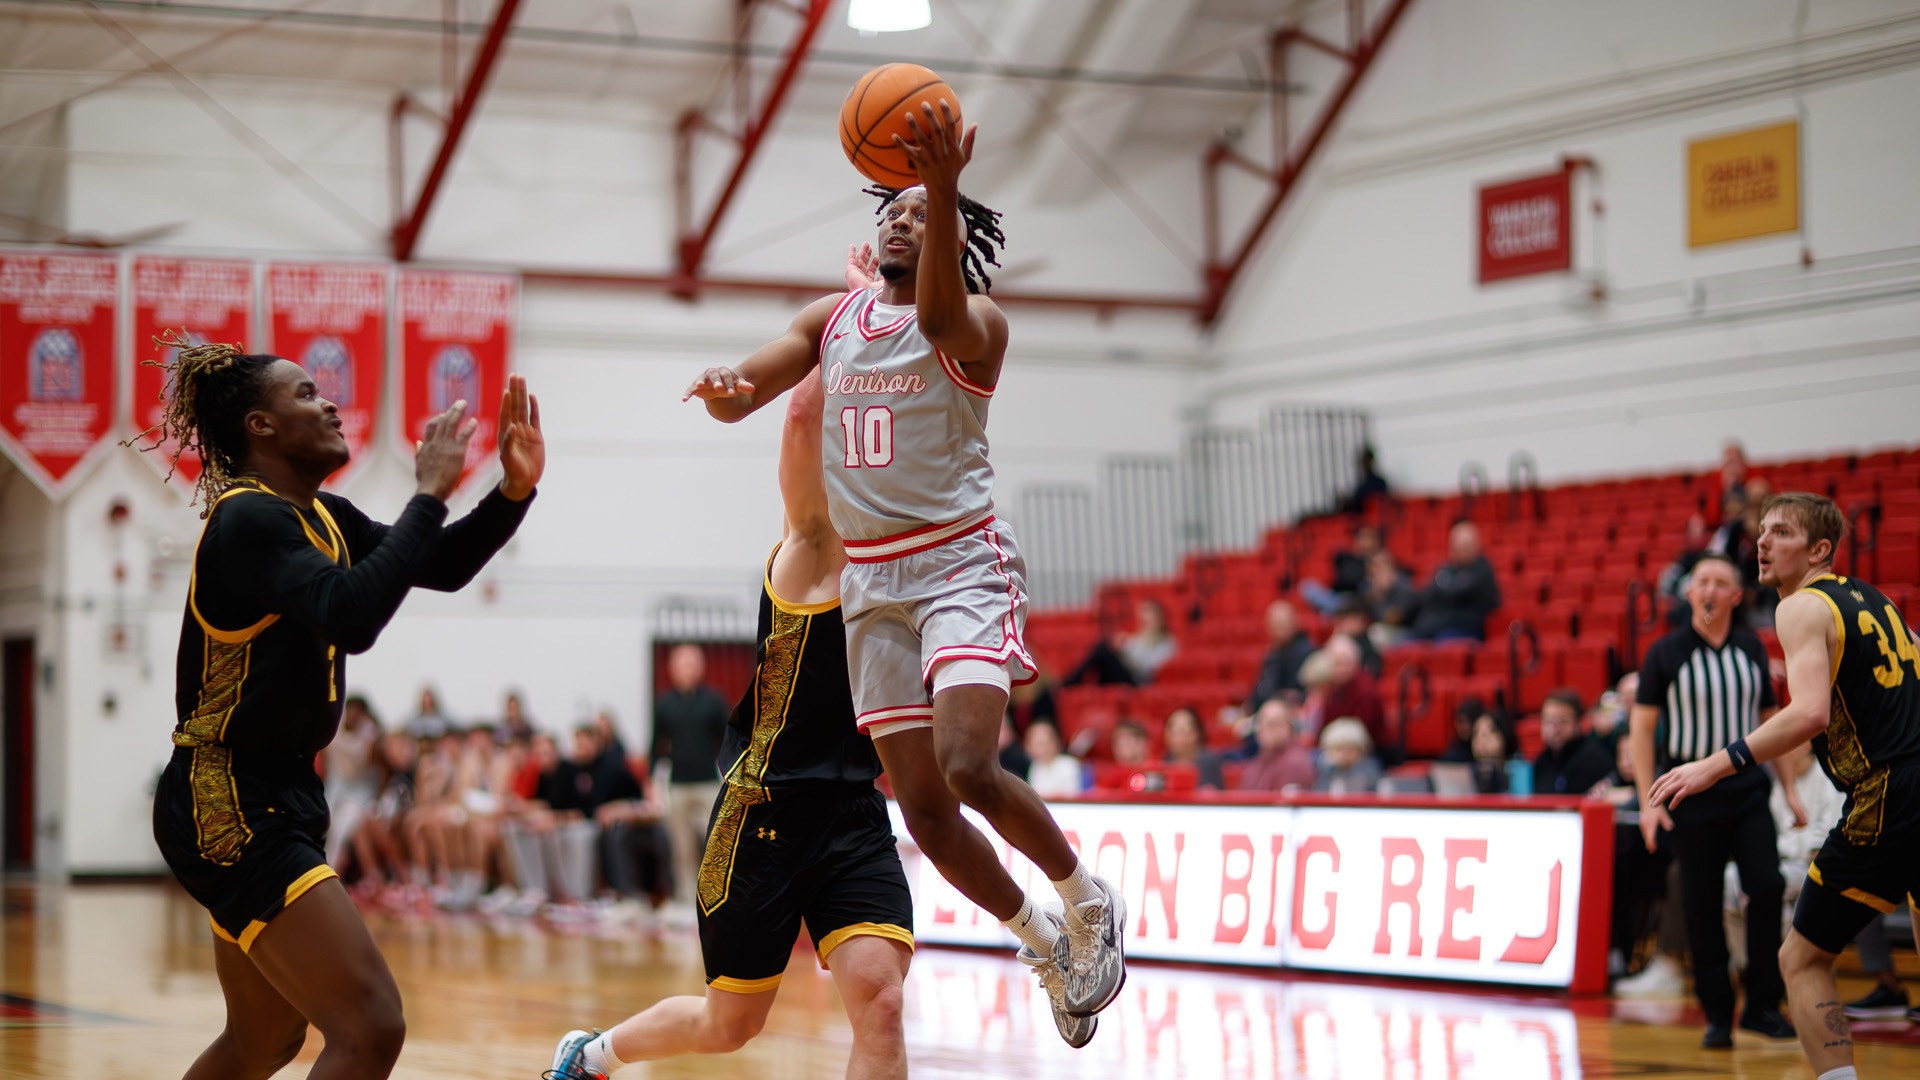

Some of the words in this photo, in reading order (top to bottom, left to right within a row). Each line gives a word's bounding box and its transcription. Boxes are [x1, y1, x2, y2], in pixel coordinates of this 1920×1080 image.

[827, 360, 927, 395] Denison
[840, 405, 894, 468] 10
[1857, 604, 1920, 689] 34
[1213, 833, 1341, 950] BIG
